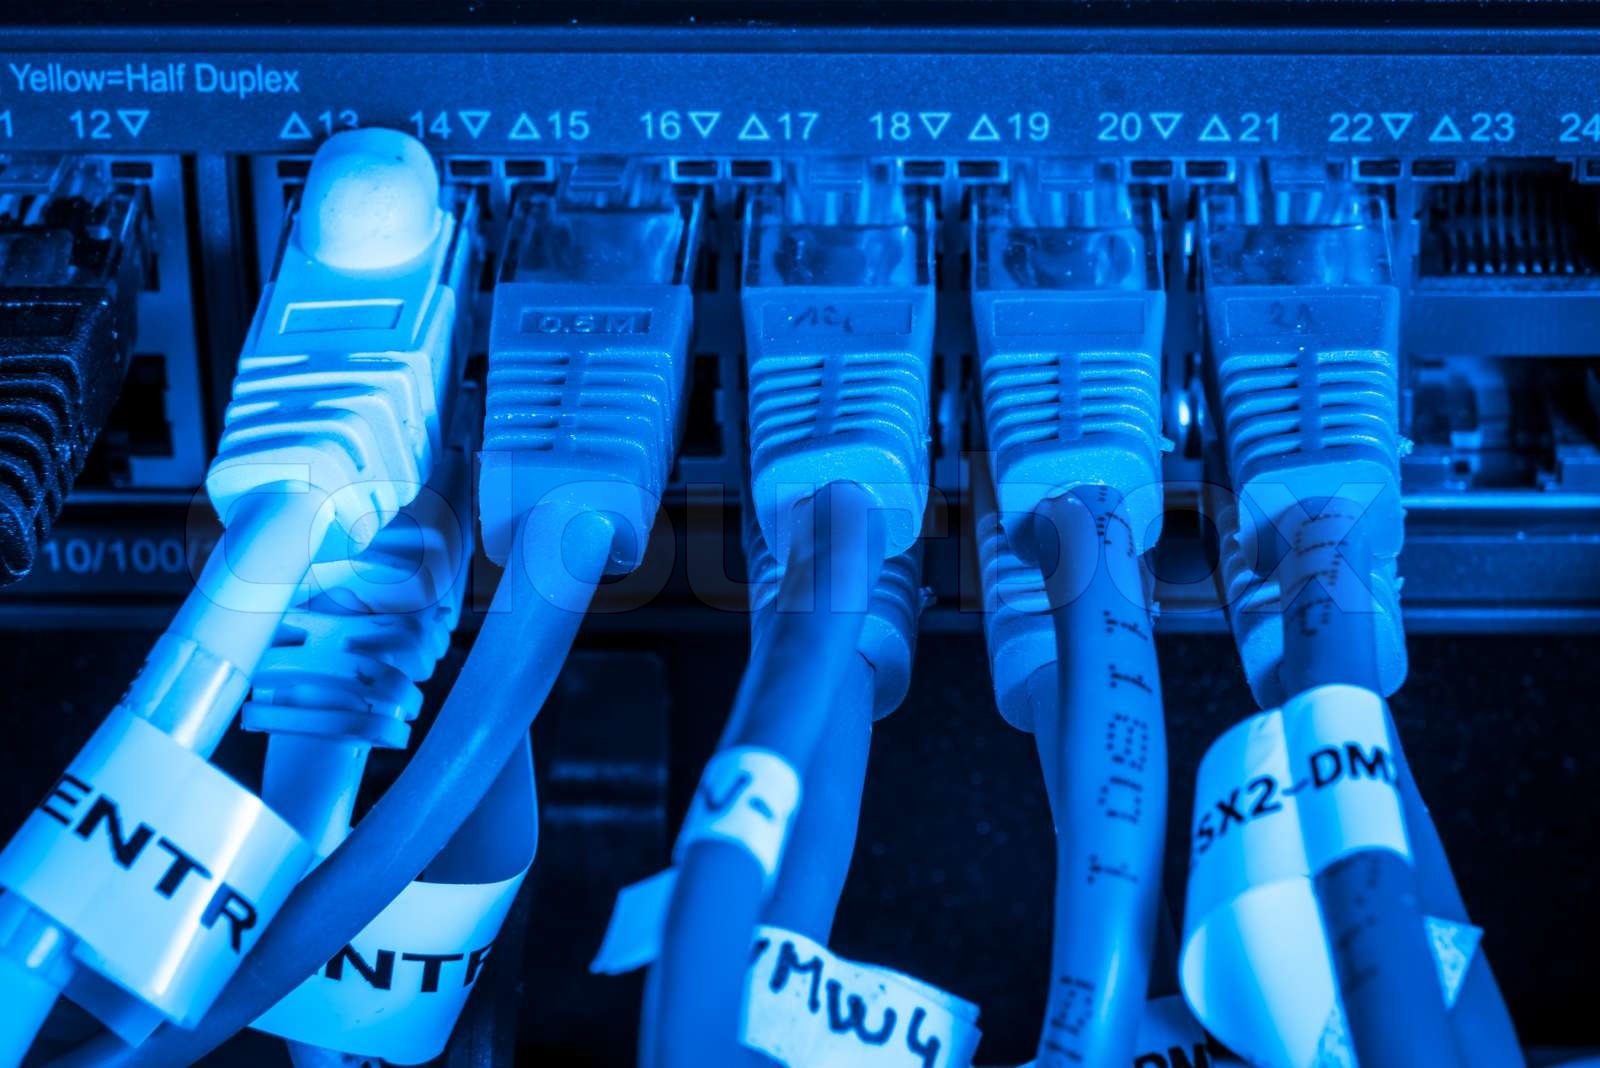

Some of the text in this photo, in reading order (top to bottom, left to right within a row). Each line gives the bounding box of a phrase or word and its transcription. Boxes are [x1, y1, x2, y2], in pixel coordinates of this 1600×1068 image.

[8, 62, 301, 99] Yellow=Half Duplex
[69, 109, 113, 139] 12
[410, 110, 451, 140] 14
[548, 110, 590, 140] 15
[640, 111, 682, 141] 16
[777, 111, 820, 141] 17
[869, 111, 912, 141] 18
[1007, 111, 1051, 142] 19
[1098, 111, 1142, 142] 20
[1238, 111, 1280, 142] 21
[1327, 112, 1374, 142] 22
[1470, 112, 1516, 142] 23
[1559, 112, 1600, 142] 24
[40, 773, 258, 954] ENTR
